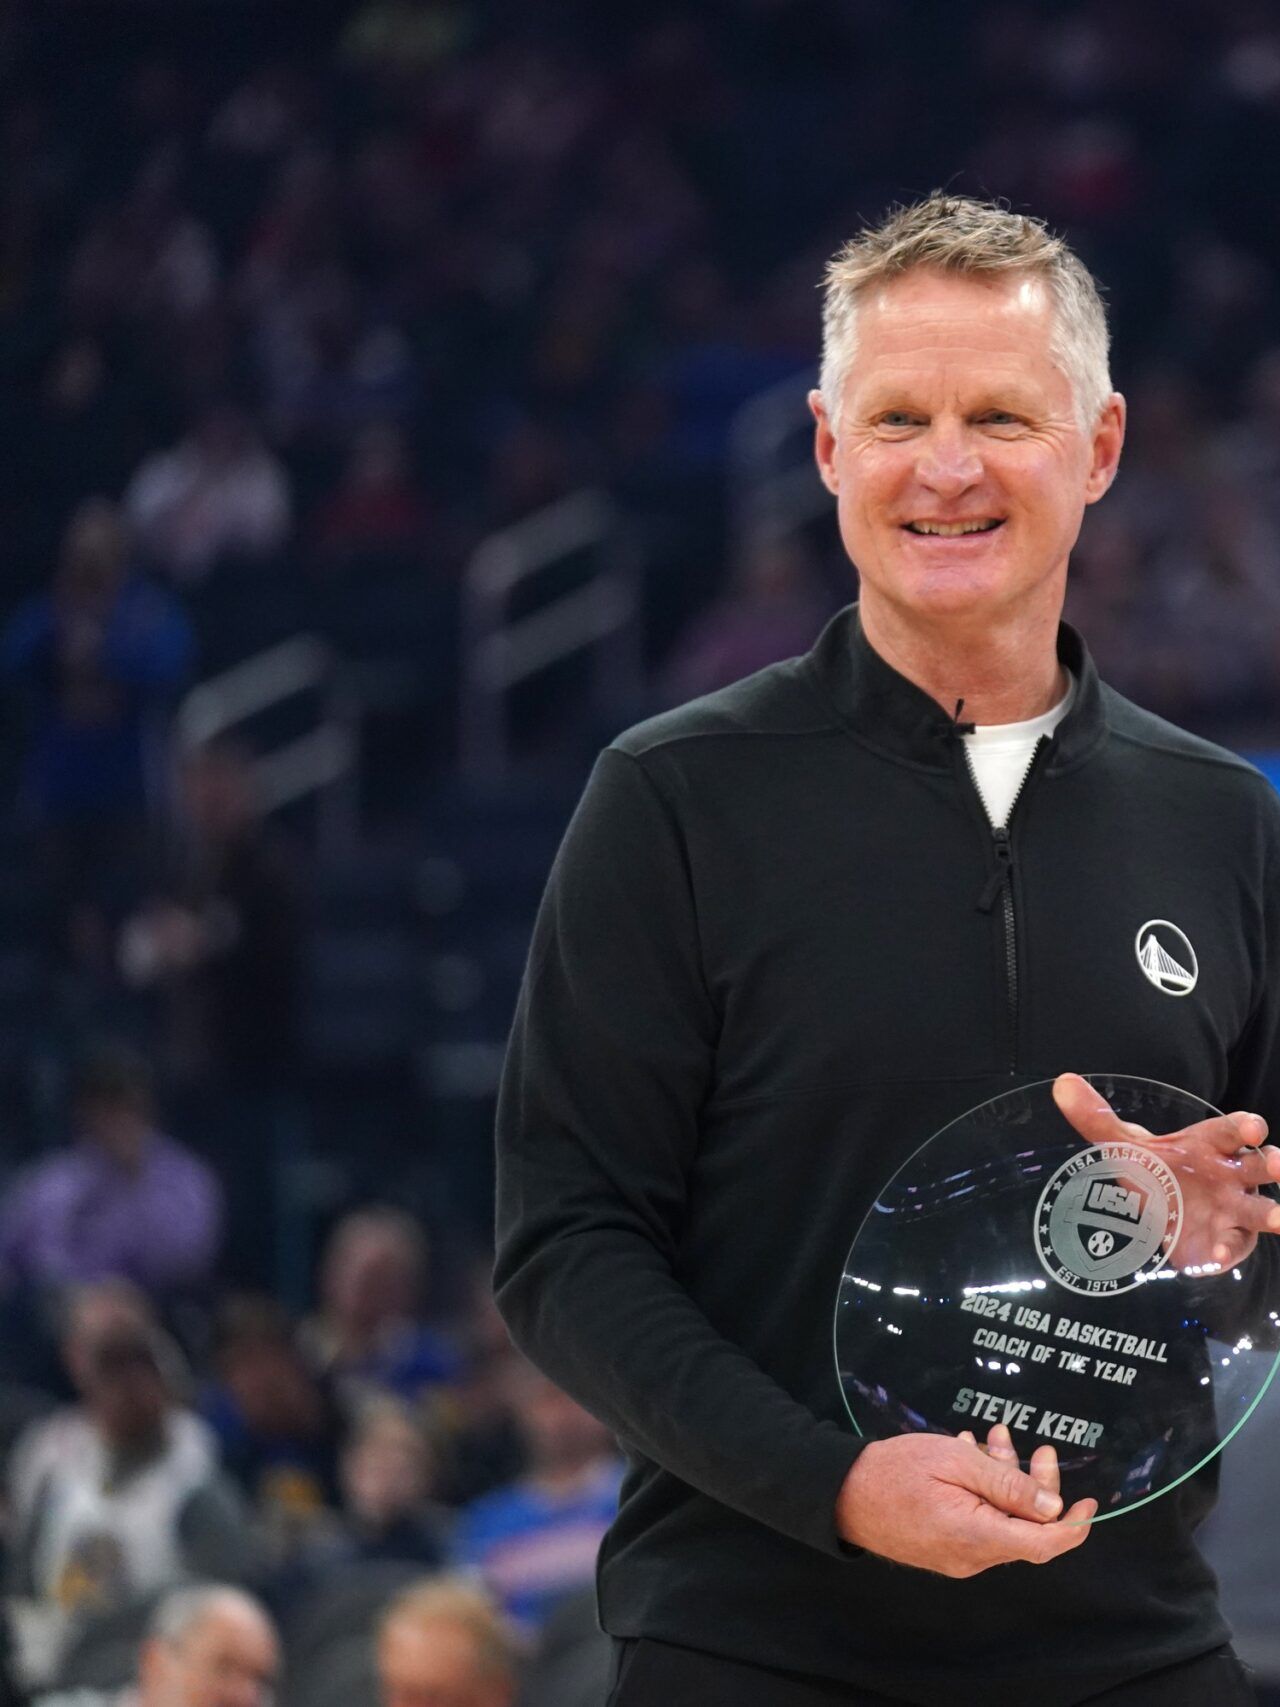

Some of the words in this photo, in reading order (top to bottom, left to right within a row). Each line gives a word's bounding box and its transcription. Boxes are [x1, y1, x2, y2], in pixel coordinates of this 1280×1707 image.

[1065, 1153, 1096, 1177] USA
[1100, 1148, 1177, 1202] BASKETBALL
[1087, 1182, 1141, 1221] USA
[1056, 1265, 1081, 1288] EST.
[1086, 1279, 1119, 1292] 1974
[960, 1293, 1012, 1322] 2024
[1014, 1306, 1051, 1334] USA
[1054, 1317, 1168, 1363] BASKETBALL
[973, 1327, 1031, 1359] COACH
[1031, 1344, 1056, 1364] OF
[1057, 1350, 1091, 1375] THE
[1093, 1359, 1138, 1386] YEAR
[952, 1387, 1037, 1432] STEVE
[1036, 1410, 1105, 1448] KERR
